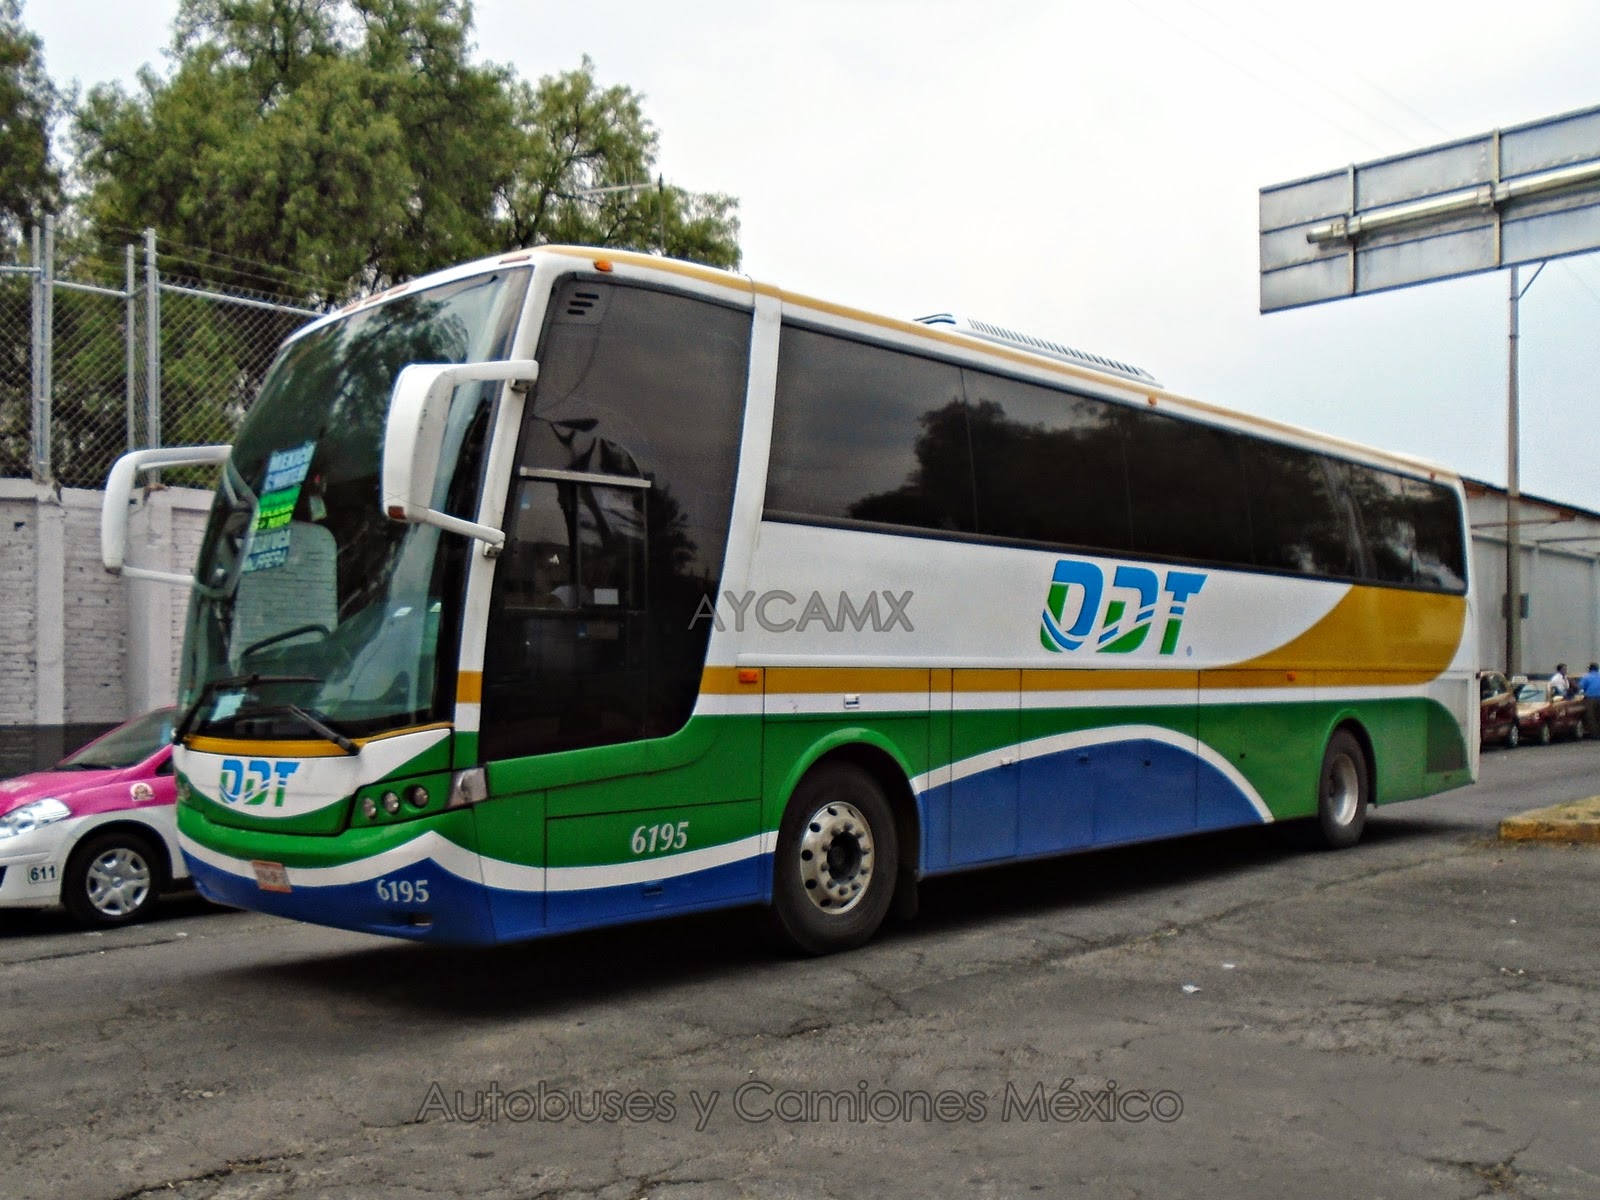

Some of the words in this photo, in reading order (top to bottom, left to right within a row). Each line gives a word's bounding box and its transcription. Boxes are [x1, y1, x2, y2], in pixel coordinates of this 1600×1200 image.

[631, 820, 690, 855] 6195
[29, 864, 57, 882] 611
[375, 878, 431, 904] 6195
